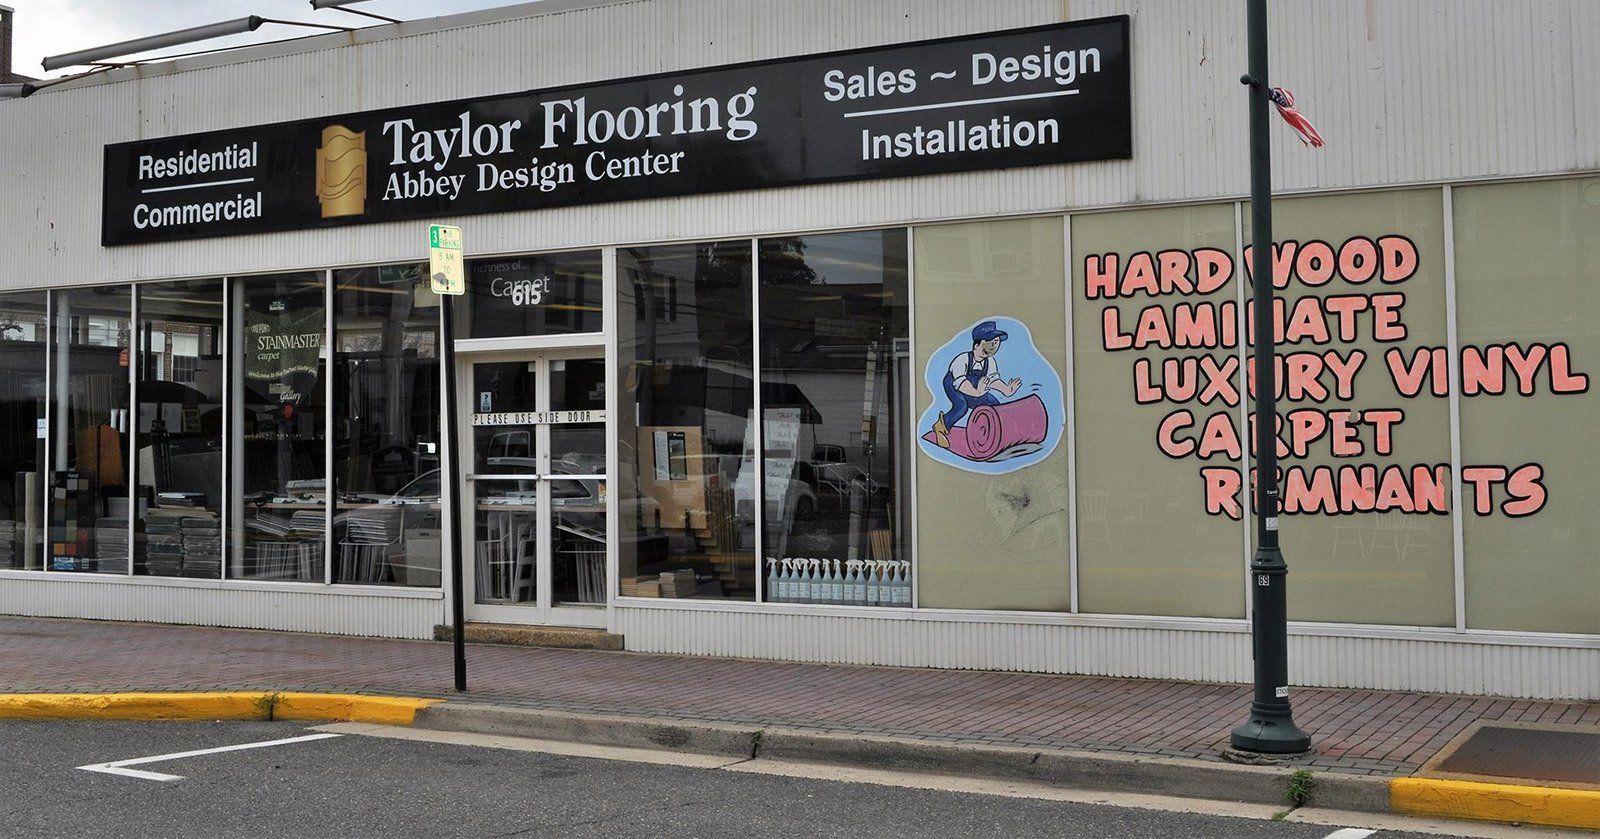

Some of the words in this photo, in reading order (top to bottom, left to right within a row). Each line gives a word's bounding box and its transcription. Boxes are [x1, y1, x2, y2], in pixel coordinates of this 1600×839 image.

[823, 66, 917, 103] Sales
[971, 44, 1101, 86] Design
[382, 110, 522, 172] Taylor
[539, 84, 758, 149] Flooring
[862, 116, 1060, 161] Installation
[138, 141, 258, 181] Residential
[382, 170, 466, 201] Abbey
[476, 158, 576, 194] Design
[585, 149, 685, 183] Center
[133, 191, 263, 229] Commercial
[432, 230, 438, 244] 3
[474, 262, 510, 273] richness
[512, 284, 541, 306] 615
[257, 334, 320, 350] STAINMASTER
[257, 352, 280, 362] carpet
[1384, 342, 1590, 398] VINYL
[280, 389, 301, 405] Gallery
[474, 413, 508, 425] PLEASE
[515, 412, 532, 424] USE
[538, 412, 559, 423] SIDE
[568, 411, 591, 422] DOOR
[1157, 408, 1405, 461] CARPET
